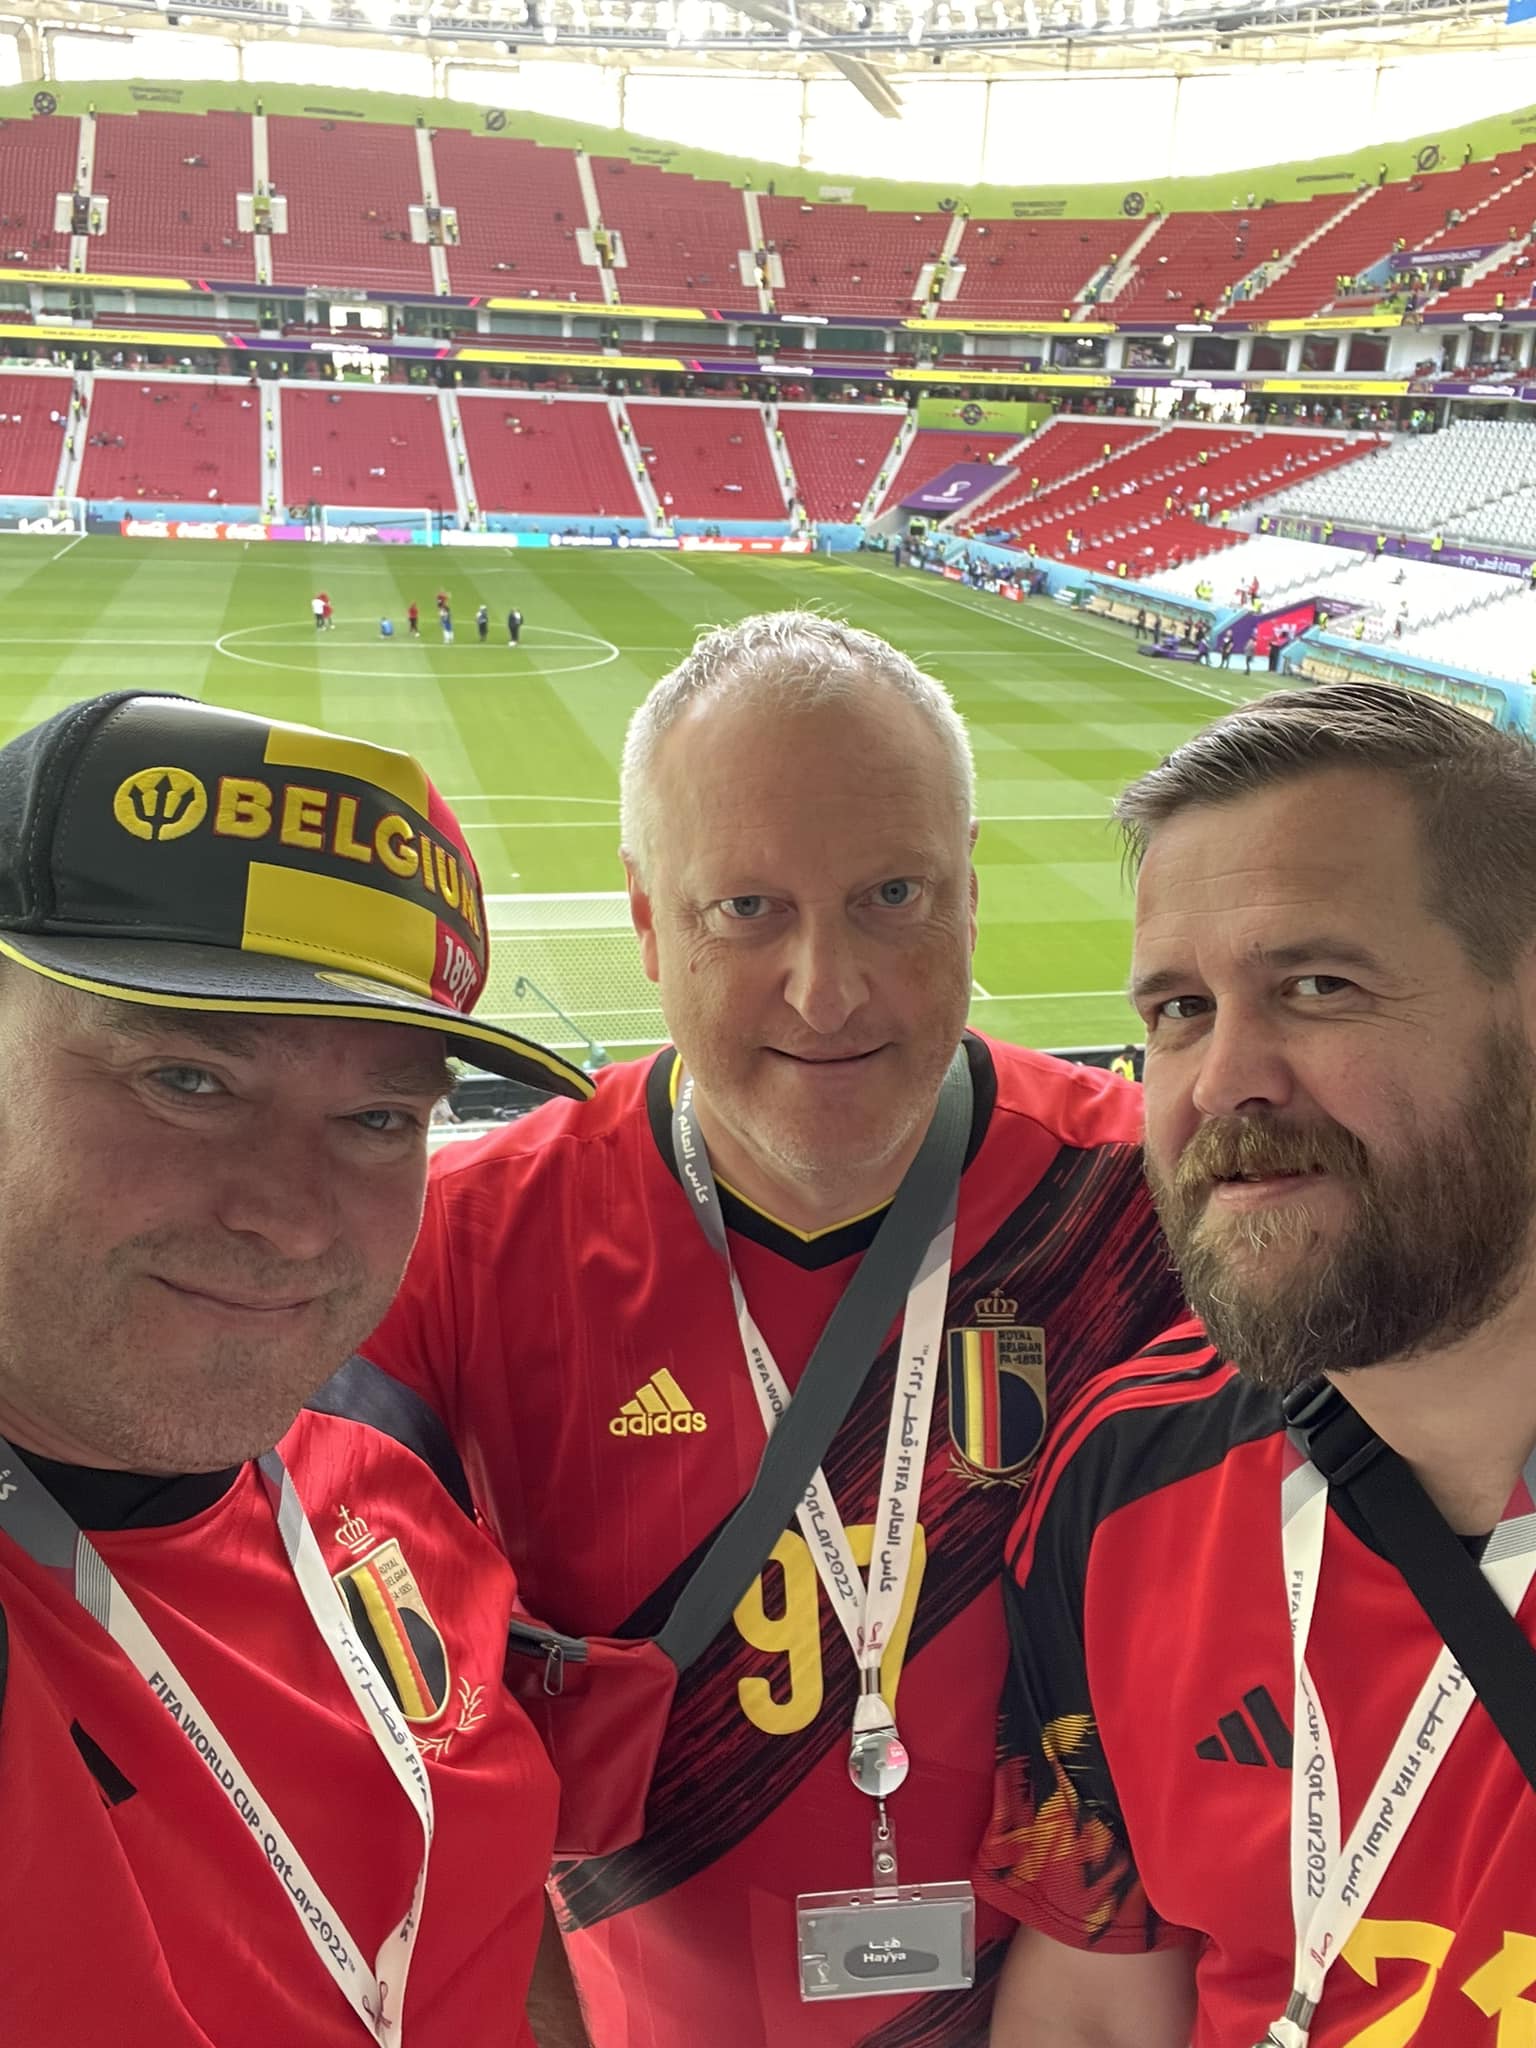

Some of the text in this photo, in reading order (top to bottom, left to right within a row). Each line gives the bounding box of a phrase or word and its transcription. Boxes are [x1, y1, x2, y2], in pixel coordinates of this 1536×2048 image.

[212, 775, 481, 941] BELGIUM
[751, 1348, 771, 1384] FIFA
[609, 1411, 708, 1437] adidas
[894, 1456, 912, 1493] FIFA
[732, 1522, 927, 1735] 97
[1307, 1702, 1321, 1742] CUP
[148, 1671, 182, 1727] FIFA
[182, 1717, 235, 1791] WORLD
[232, 1787, 260, 1829] CUP
[1391, 1754, 1421, 1798] FIFA
[863, 1951, 907, 1963] Hayya
